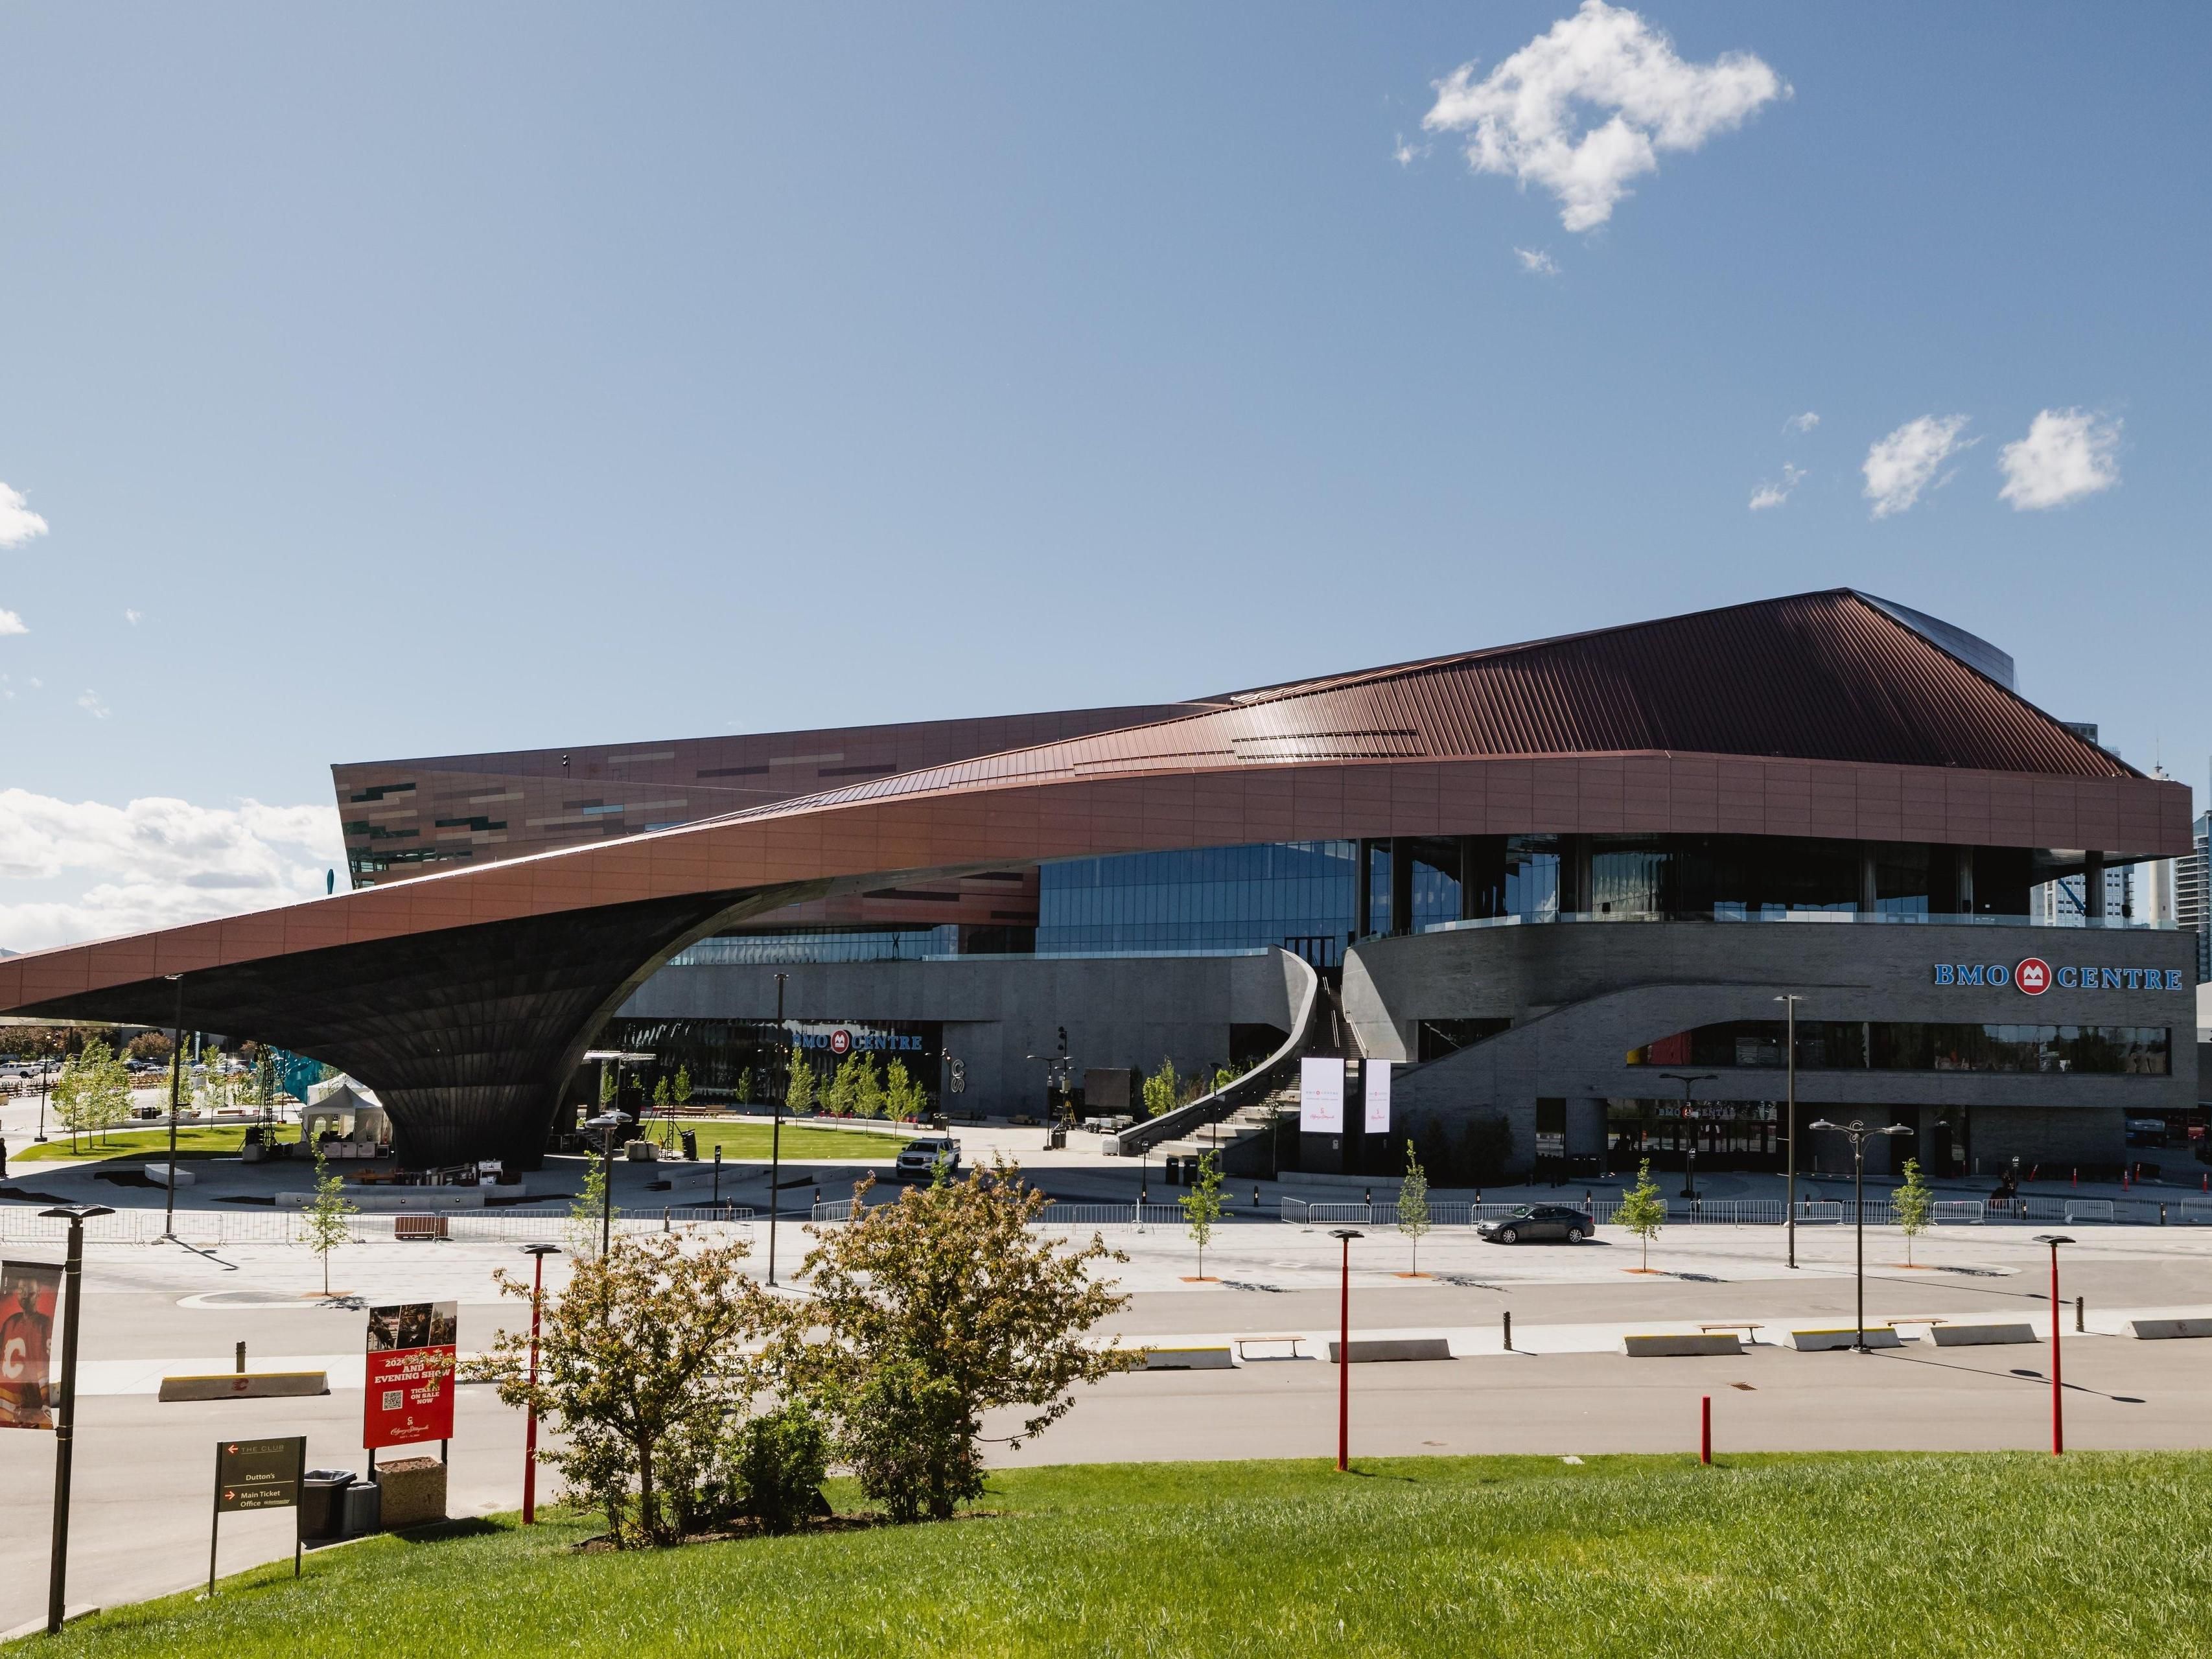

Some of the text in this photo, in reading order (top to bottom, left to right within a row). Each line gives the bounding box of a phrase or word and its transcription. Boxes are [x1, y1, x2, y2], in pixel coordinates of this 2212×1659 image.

[1934, 964, 2183, 991] BMO CENTRE
[791, 1034, 923, 1050] BMO CENTRE
[402, 1364, 425, 1373] AND
[375, 1369, 450, 1384] EVENING SHOW
[246, 1472, 275, 1481] Dutton's
